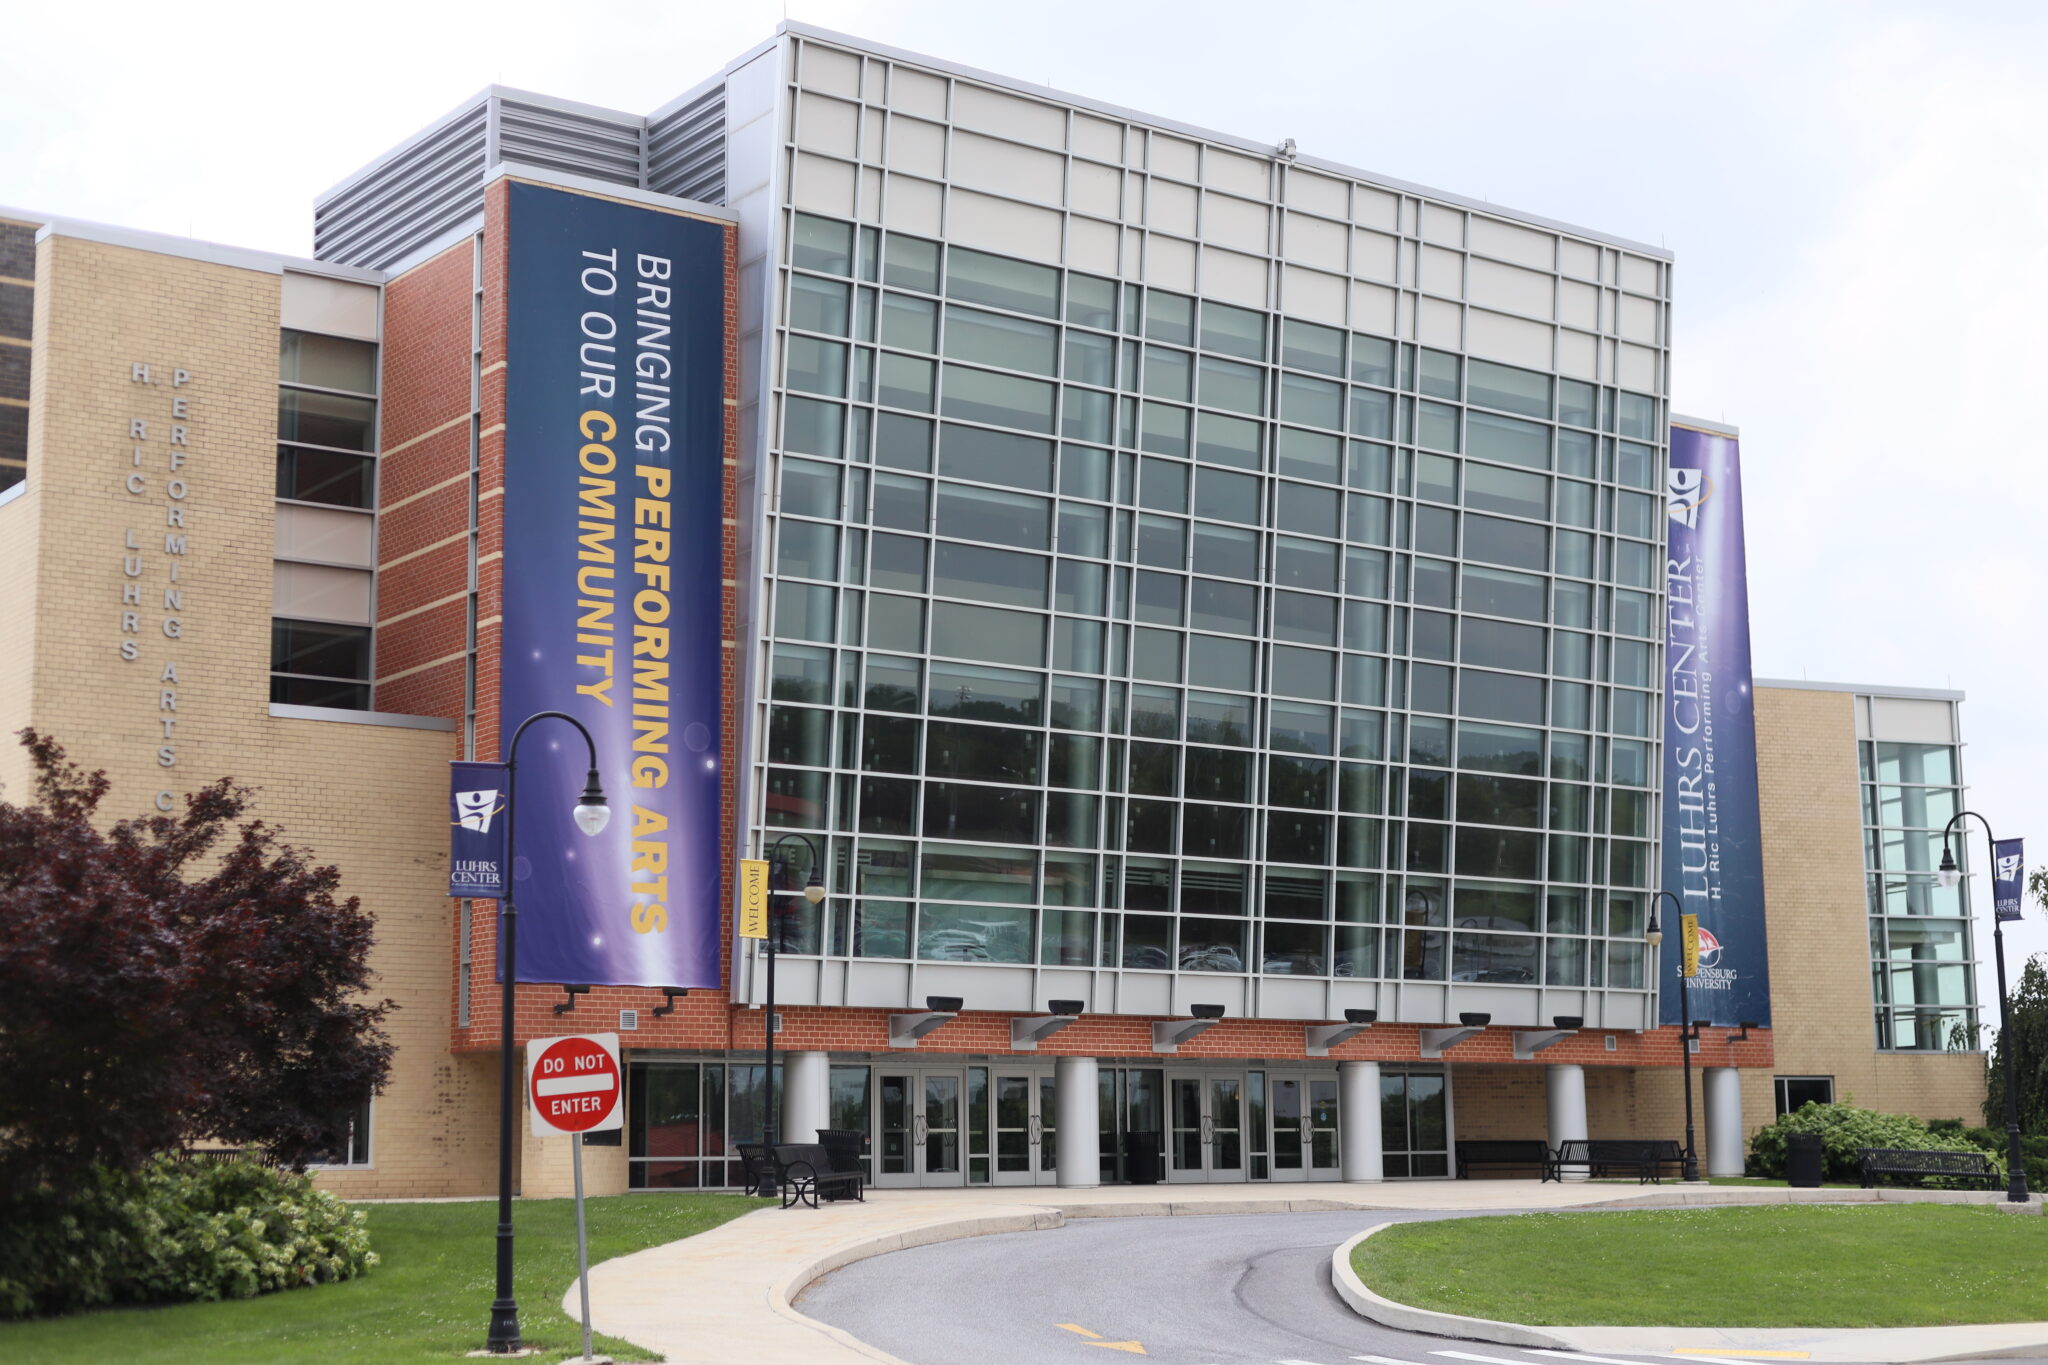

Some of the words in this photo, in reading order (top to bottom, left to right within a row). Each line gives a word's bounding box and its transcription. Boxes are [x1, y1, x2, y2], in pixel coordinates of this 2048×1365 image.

[580, 248, 617, 296] TO
[131, 361, 159, 386] H.
[579, 311, 617, 399] OUR
[635, 252, 671, 453] BRINGING
[126, 416, 147, 494] RIC
[162, 367, 190, 639] PERFORMING
[575, 409, 617, 708] COMMUNITY
[1695, 555, 1706, 616] Center
[120, 527, 143, 661] LUHRS
[630, 464, 671, 790] PERFORMING
[1667, 555, 1701, 734] CENTER
[1698, 624, 1709, 664] Arts
[158, 661, 179, 768] ARTS
[1701, 671, 1715, 774] Performing
[1676, 746, 1709, 901] LUHRS
[1706, 782, 1718, 834] Luhrs
[451, 871, 501, 884] CENTER
[455, 859, 497, 872] LUHRS
[629, 804, 669, 935] ARTS
[1709, 842, 1720, 872] Ric
[748, 865, 760, 932] WELCOME
[1711, 880, 1722, 900] H.
[1676, 964, 1738, 980] SPENSBURG
[1686, 920, 1695, 973] WELCOME
[543, 1058, 565, 1074] DO
[574, 1053, 605, 1071] NOT
[551, 1096, 601, 1116] ENTER
